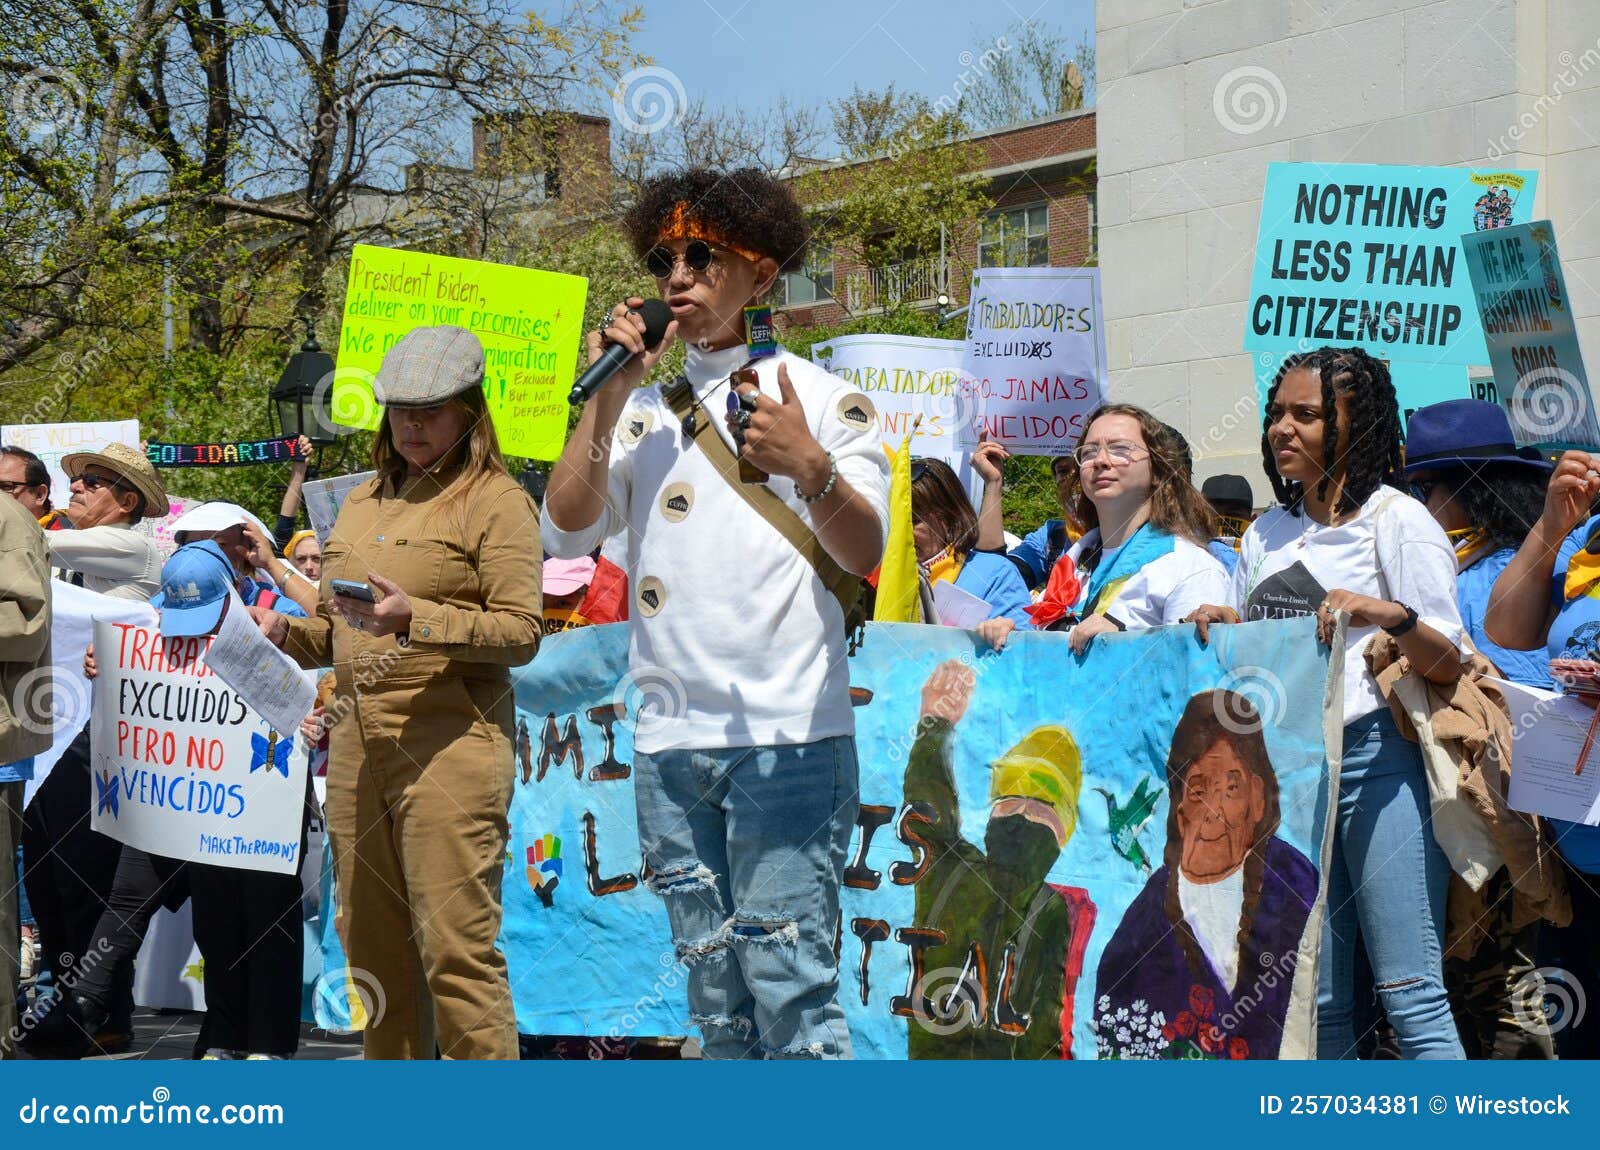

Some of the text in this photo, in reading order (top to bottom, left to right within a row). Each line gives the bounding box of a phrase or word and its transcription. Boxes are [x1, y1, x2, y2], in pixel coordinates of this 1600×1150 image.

[1293, 182, 1449, 230] NOTHING
[352, 258, 488, 308] President Biden,
[1271, 239, 1457, 288] LESS THAN
[1478, 236, 1530, 284] WE ARE
[349, 290, 403, 318] deliver
[408, 303, 426, 321] on
[431, 304, 465, 328] your
[469, 310, 552, 342] promises
[978, 297, 1092, 333] TRABAJADORES
[1252, 294, 1462, 347] CITIZENSHIP
[345, 326, 375, 354] We
[485, 342, 558, 377] migration
[514, 372, 556, 386] Excluded
[1001, 376, 1089, 404] JAMAS
[513, 404, 564, 418] DEFEATED
[147, 438, 299, 464] SOLIDARITY
[117, 720, 224, 772] PERO NO
[842, 801, 940, 891] IS
